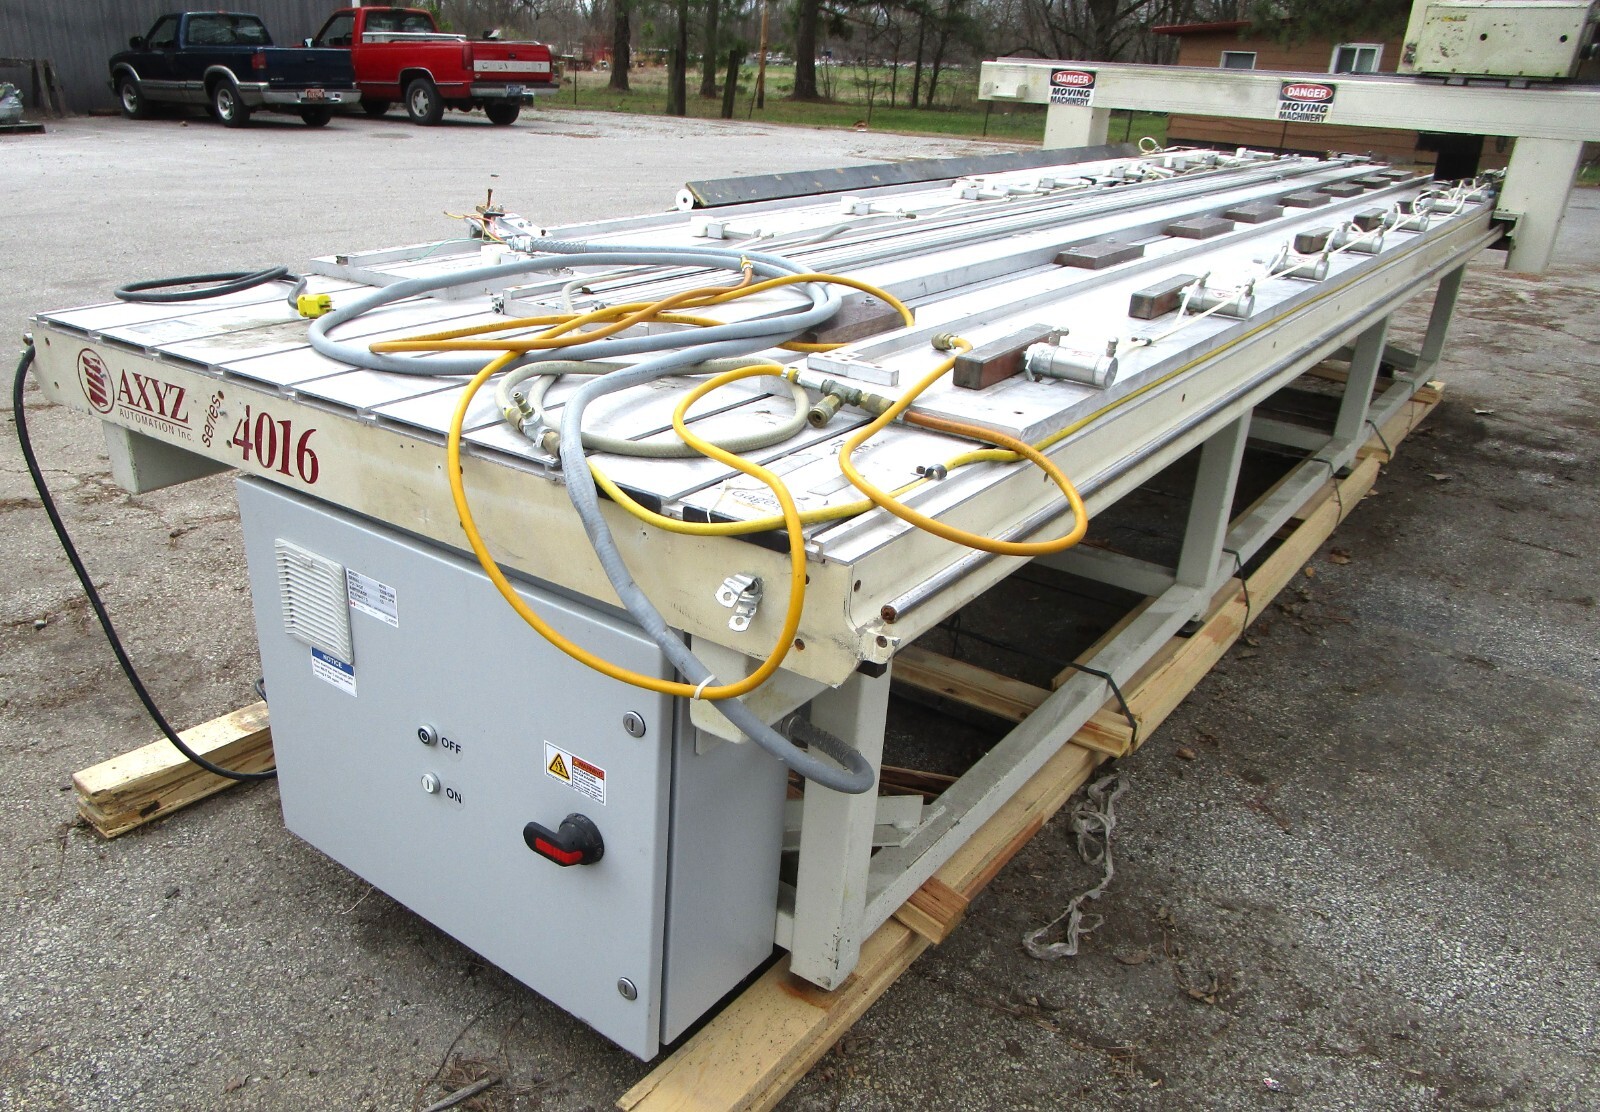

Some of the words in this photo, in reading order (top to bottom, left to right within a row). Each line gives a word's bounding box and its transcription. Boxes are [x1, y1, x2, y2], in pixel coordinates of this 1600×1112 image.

[1056, 74, 1089, 84] DANGER
[1051, 87, 1091, 98] MOVING
[1287, 87, 1327, 98] DANGER
[1050, 96, 1090, 106] MACHINERY
[1280, 102, 1329, 113] MOVING
[1278, 111, 1327, 122] MACHINERY
[117, 368, 189, 424] AXYZ
[119, 407, 175, 435] AUTOMATION
[201, 395, 222, 448] series
[232, 404, 320, 485] 4016
[322, 653, 343, 669] NOTICE
[441, 737, 462, 754] OFF
[446, 787, 462, 804] ON
